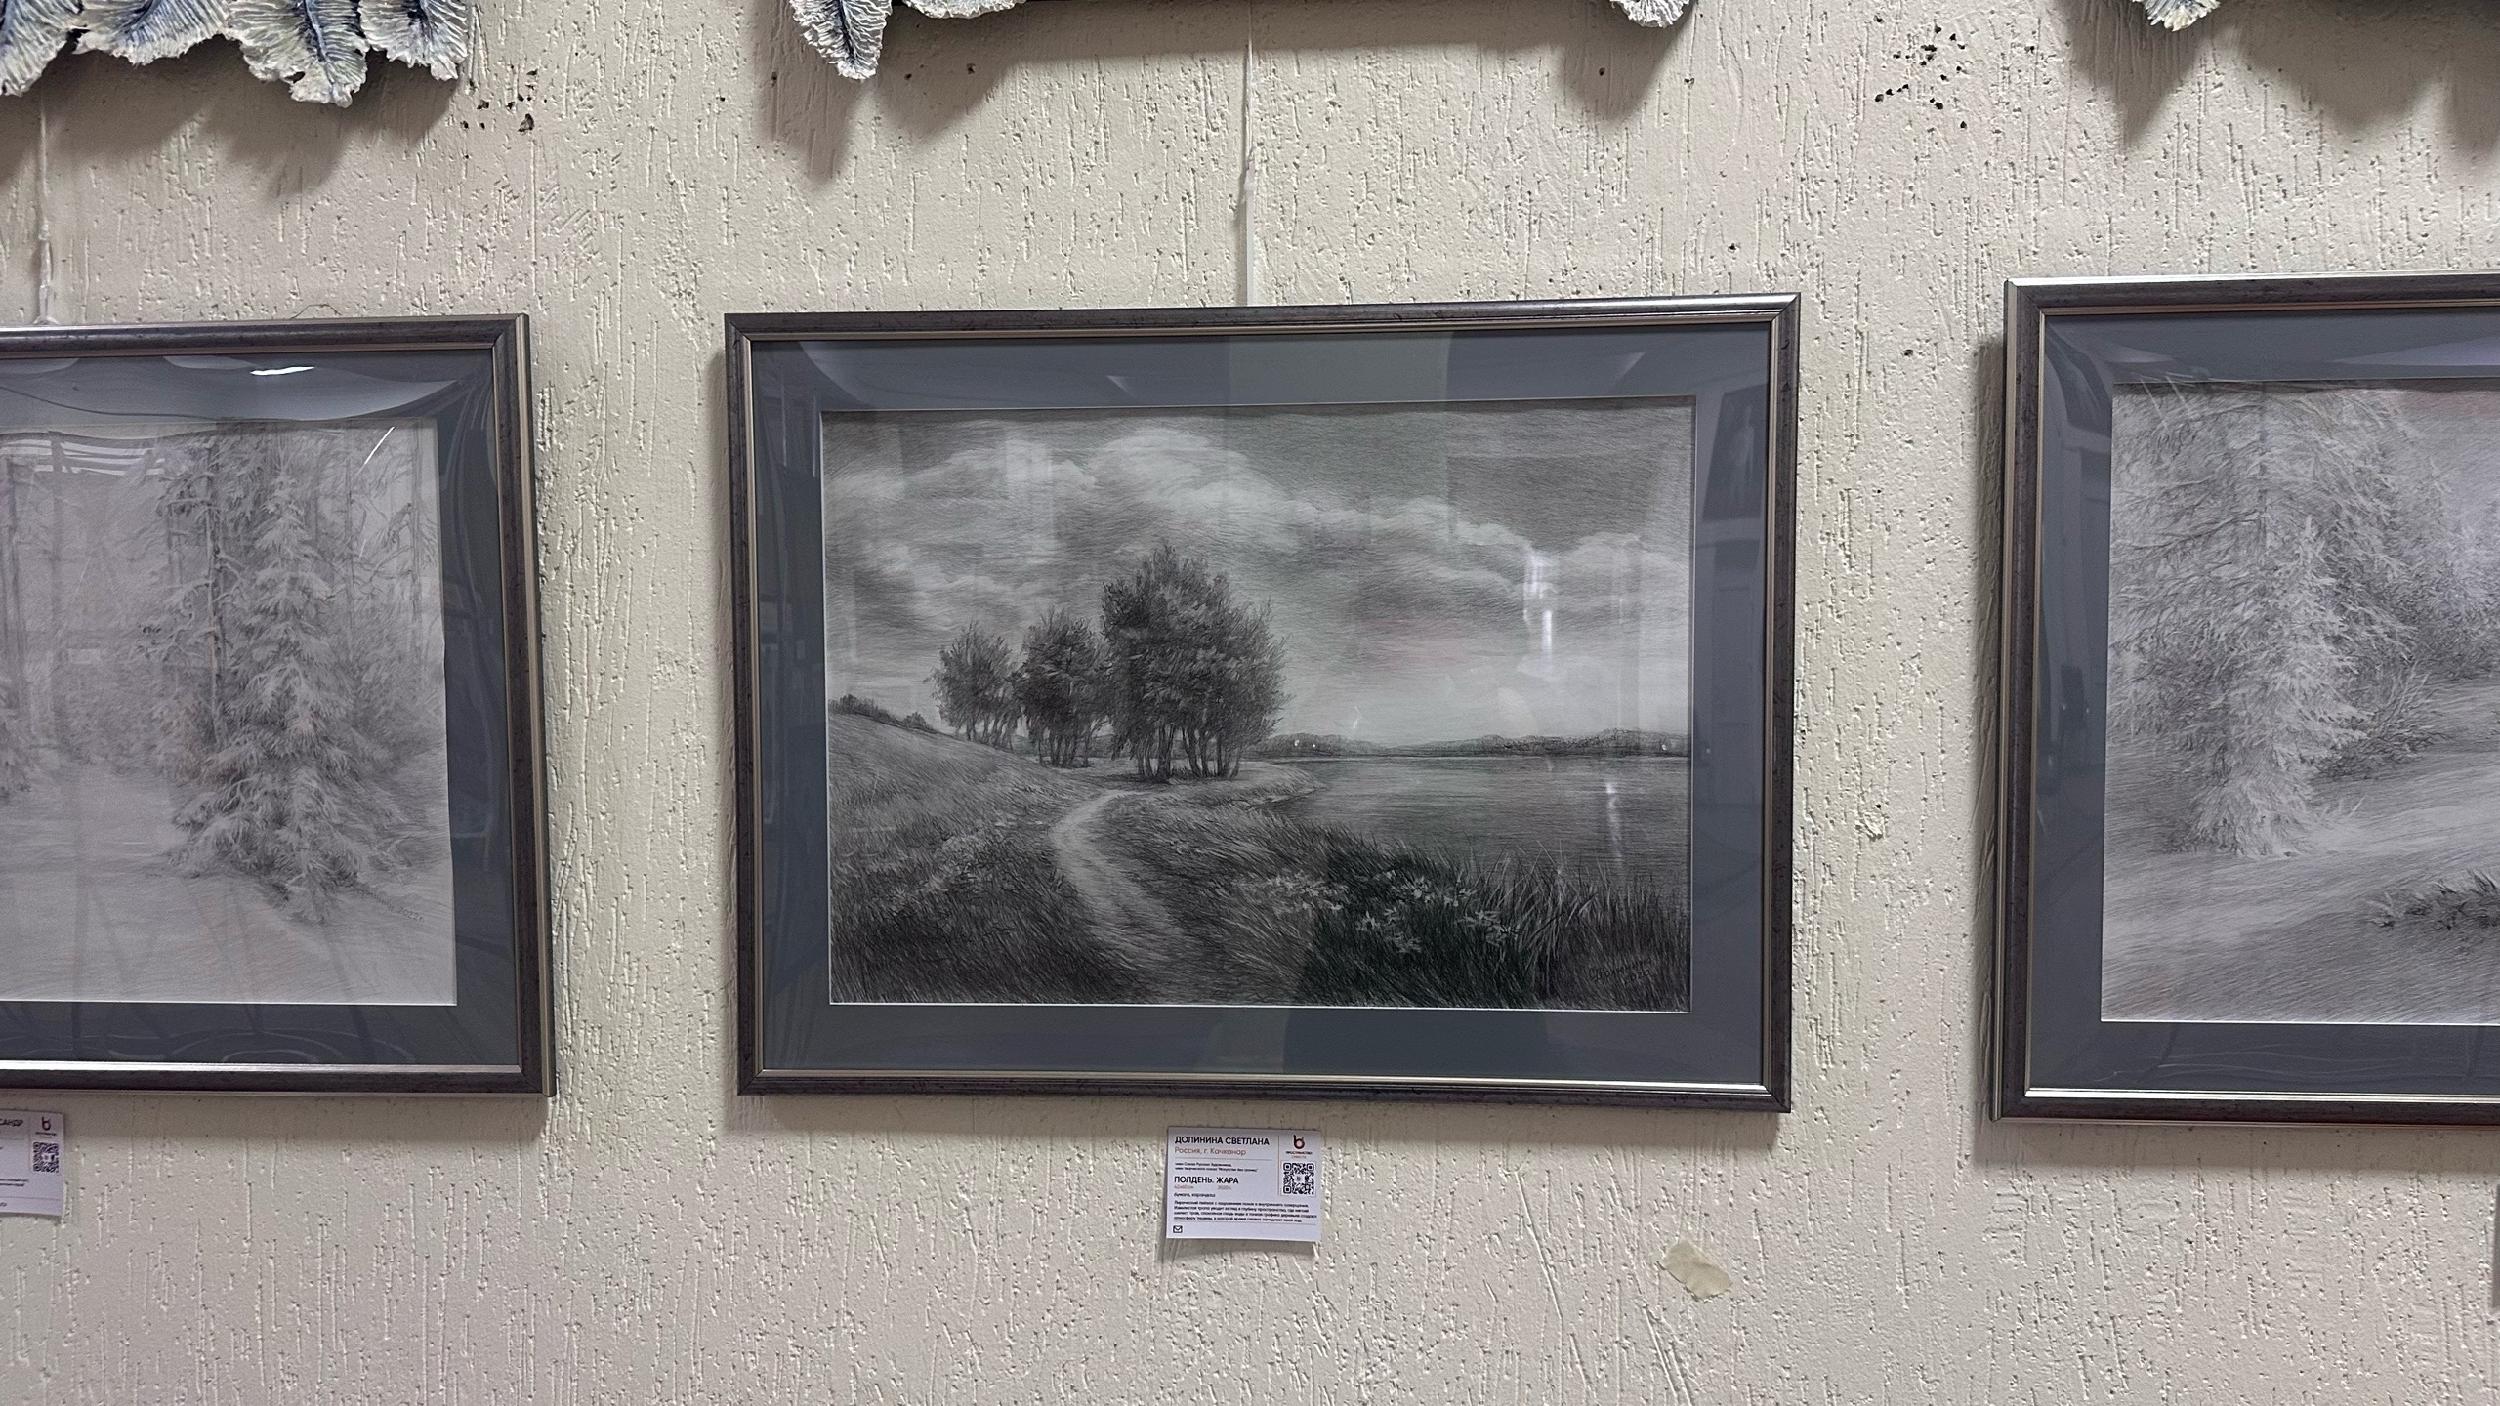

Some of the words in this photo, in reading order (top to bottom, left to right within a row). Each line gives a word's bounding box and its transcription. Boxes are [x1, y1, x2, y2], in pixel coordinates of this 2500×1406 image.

[1174, 1136, 1223, 1145] ДОЛИНИНА
[1225, 1136, 1271, 1146] СВЕТЛАНА
[1174, 1146, 1202, 1155] Россия,
[1210, 1147, 1247, 1156] Качканар
[1174, 1176, 1214, 1184] ПОЛДЕНЬ.
